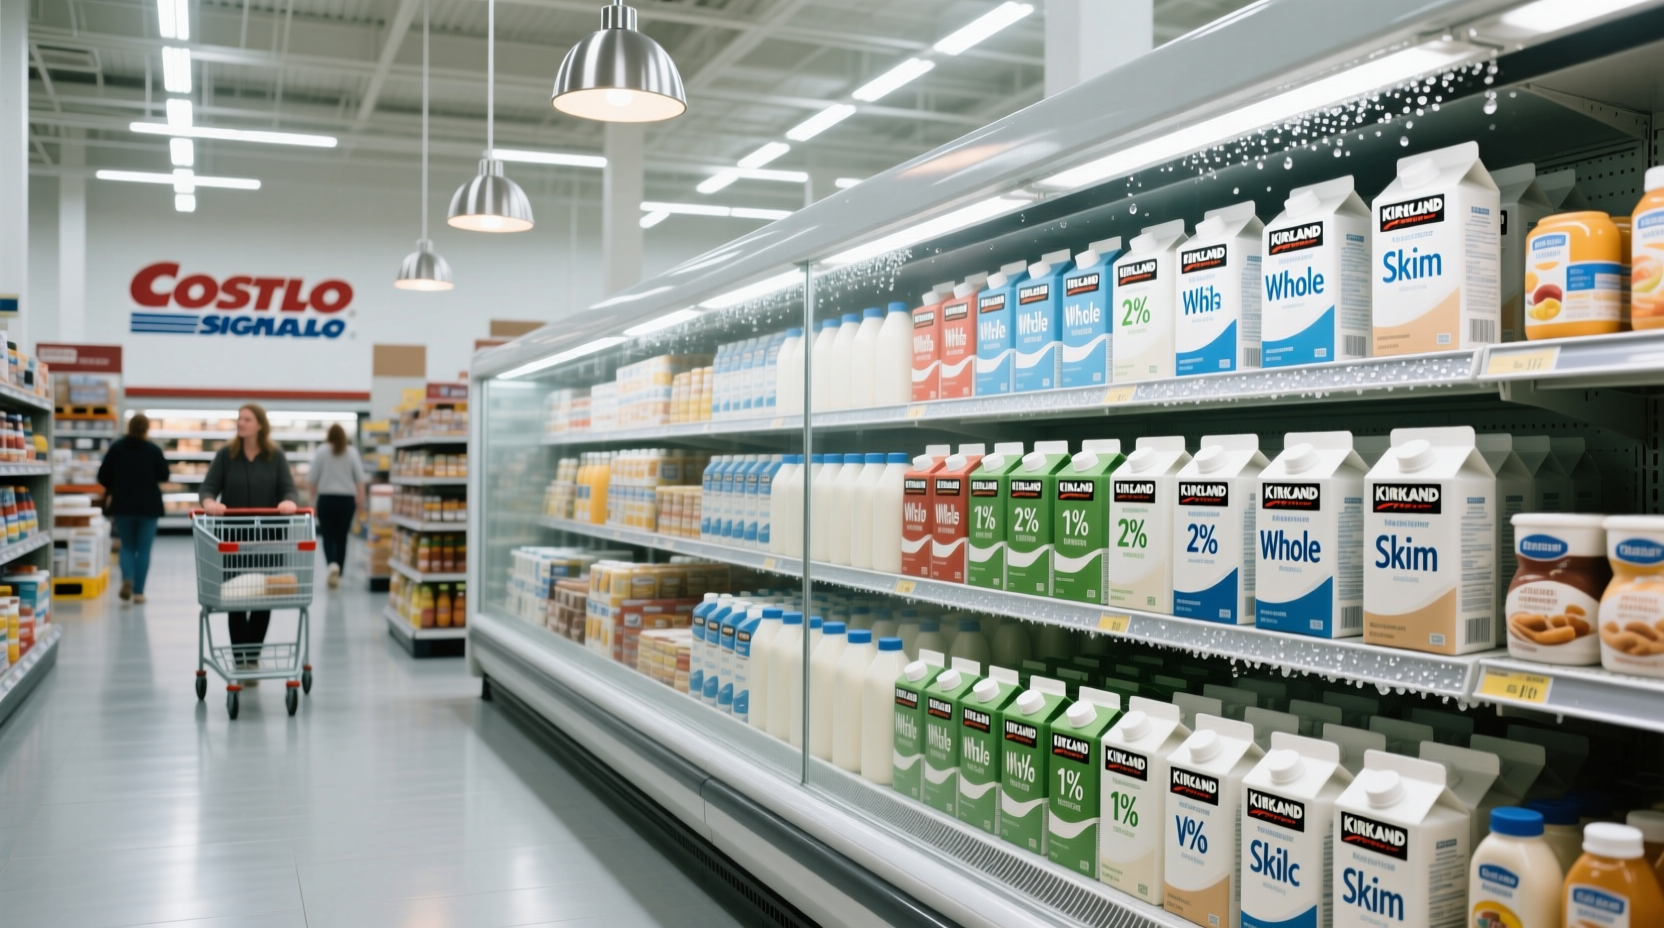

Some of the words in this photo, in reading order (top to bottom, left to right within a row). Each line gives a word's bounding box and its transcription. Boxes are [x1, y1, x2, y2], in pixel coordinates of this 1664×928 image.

[1382, 247, 1442, 283] Skim
[129, 262, 354, 314] COSTLO
[1265, 266, 1325, 302] Whole
[1065, 301, 1101, 328] Whole
[1121, 296, 1151, 326] 2%
[1375, 486, 1439, 502] KIRKAND
[974, 505, 996, 530] 1%
[1014, 507, 1039, 533] 2%
[1062, 509, 1089, 536] 1%
[1117, 518, 1147, 549] 2%
[1186, 523, 1218, 554] 2%
[1260, 530, 1321, 563] Whole
[1375, 534, 1438, 572] Skim
[1057, 767, 1084, 801] 1%
[1110, 791, 1139, 827] 1%
[1175, 814, 1208, 854] V%
[1344, 815, 1406, 847] KIRKAND
[1342, 867, 1404, 921] Skim
